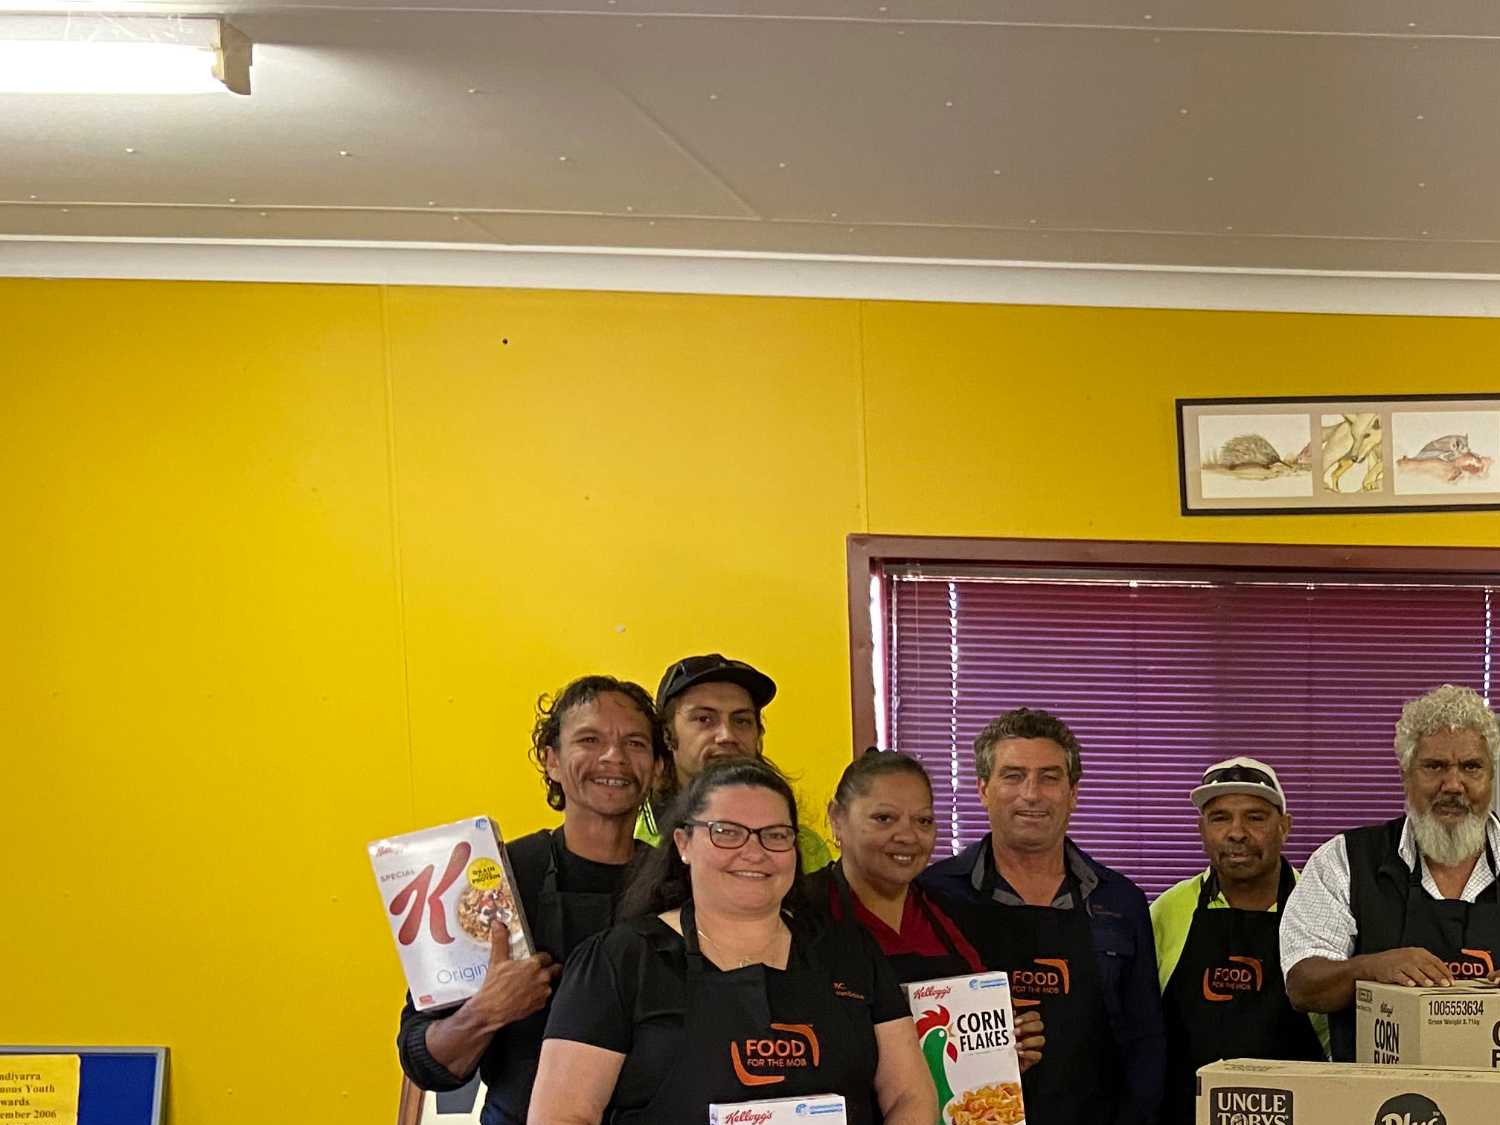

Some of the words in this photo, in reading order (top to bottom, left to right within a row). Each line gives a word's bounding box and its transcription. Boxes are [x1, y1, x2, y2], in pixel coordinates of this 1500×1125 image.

[380, 869, 416, 883] SPECIAL
[389, 841, 472, 946] K
[437, 963, 488, 984] Origin
[1013, 970, 1058, 985] FOOD
[1214, 967, 1252, 982] FOOD
[912, 985, 952, 1000] Kellogg's
[1428, 1000, 1484, 1016] 1005553634
[957, 1008, 1007, 1034] CORN
[960, 1029, 1010, 1052] FLAKES
[1374, 1017, 1400, 1054] CORN
[746, 1039, 806, 1057] FOOD
[747, 1058, 765, 1067] FOR
[768, 1058, 785, 1067] THE
[26, 1084, 55, 1093] Youth
[1217, 1091, 1286, 1113] UNCLE
[0, 1110, 31, 1119] ember
[33, 1110, 57, 1119] 2006
[725, 1109, 774, 1125] Kellogg's
